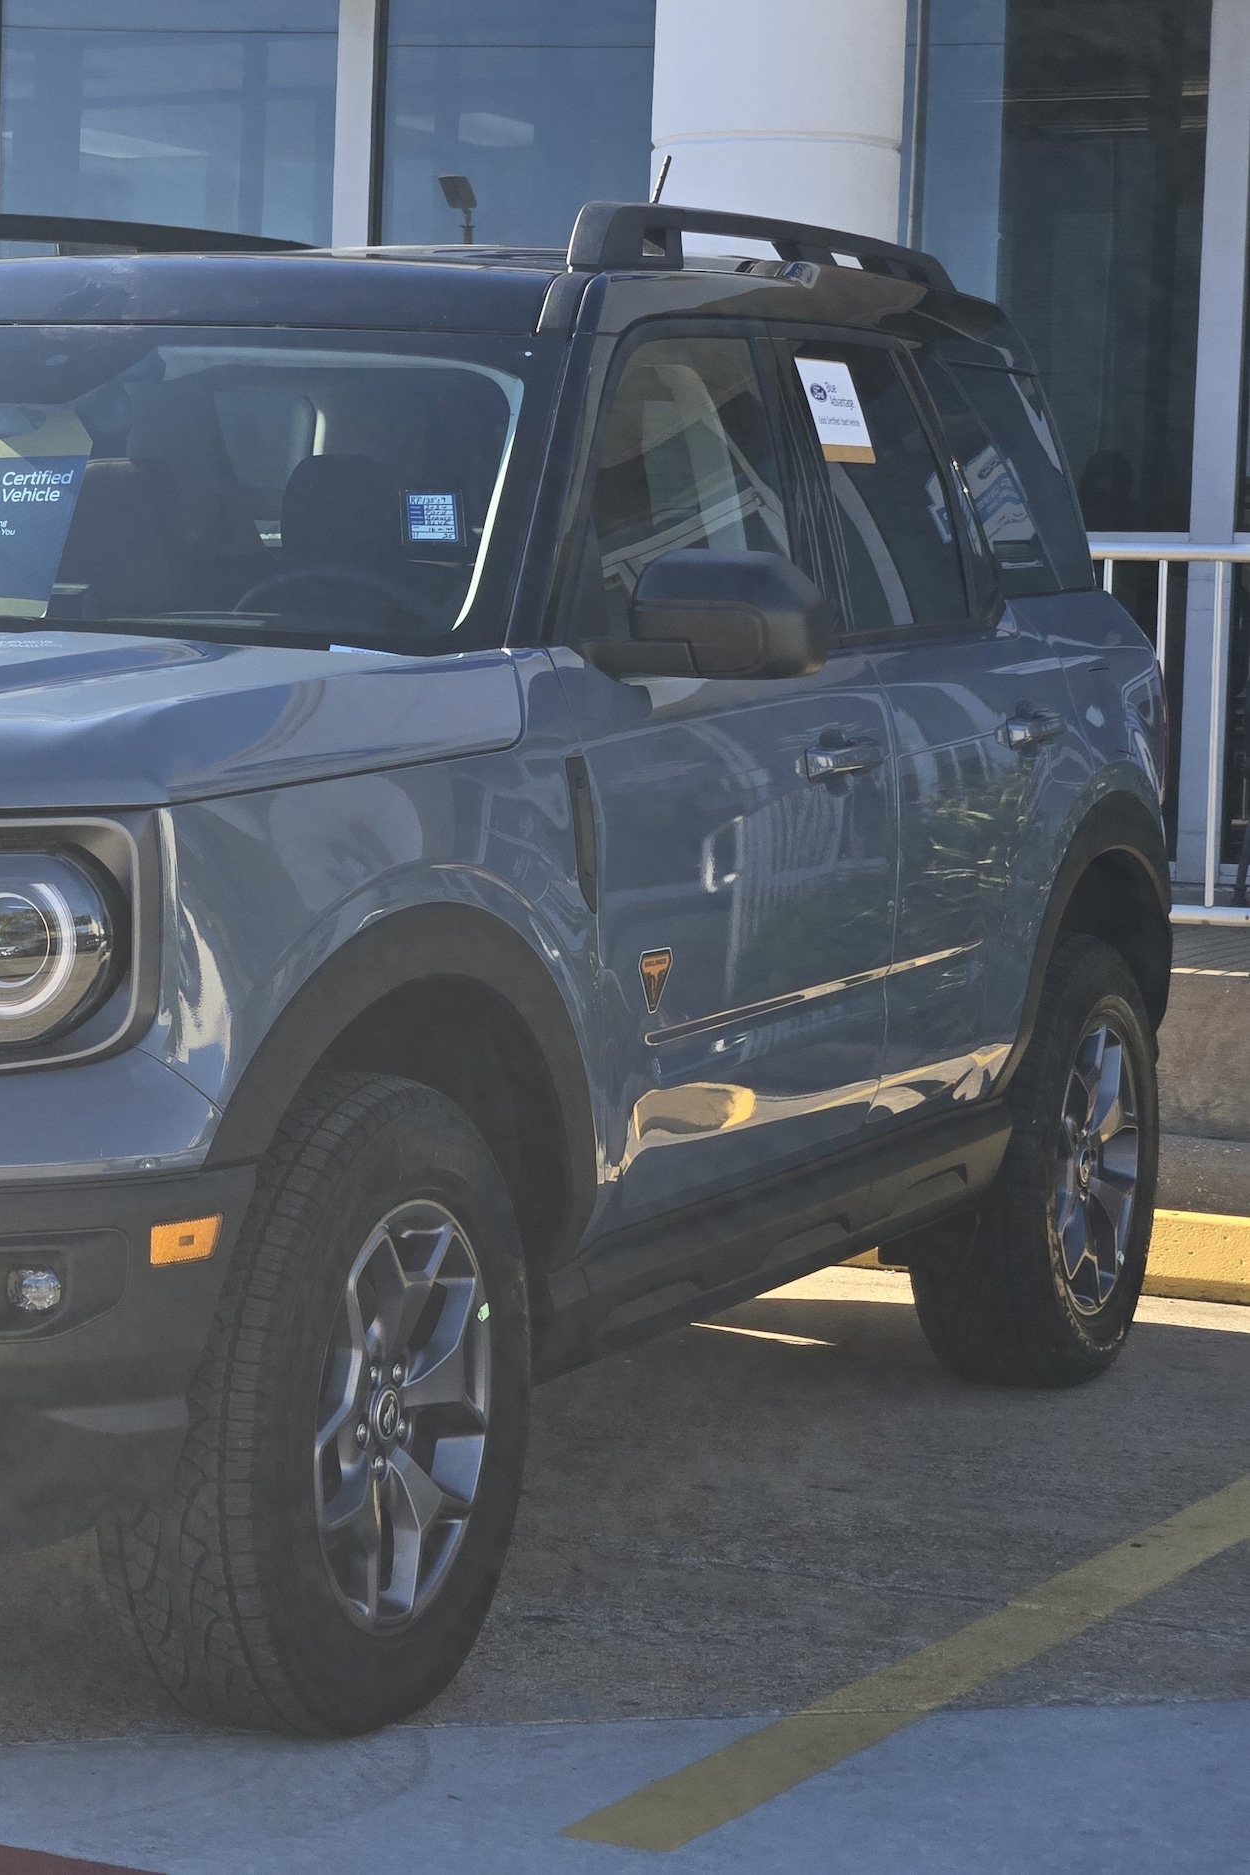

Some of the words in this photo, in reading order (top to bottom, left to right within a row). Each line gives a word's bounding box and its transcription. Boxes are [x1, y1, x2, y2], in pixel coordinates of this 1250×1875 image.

[2, 469, 75, 486] Certified
[2, 487, 61, 503] Vehicle
[1, 528, 16, 536] You
